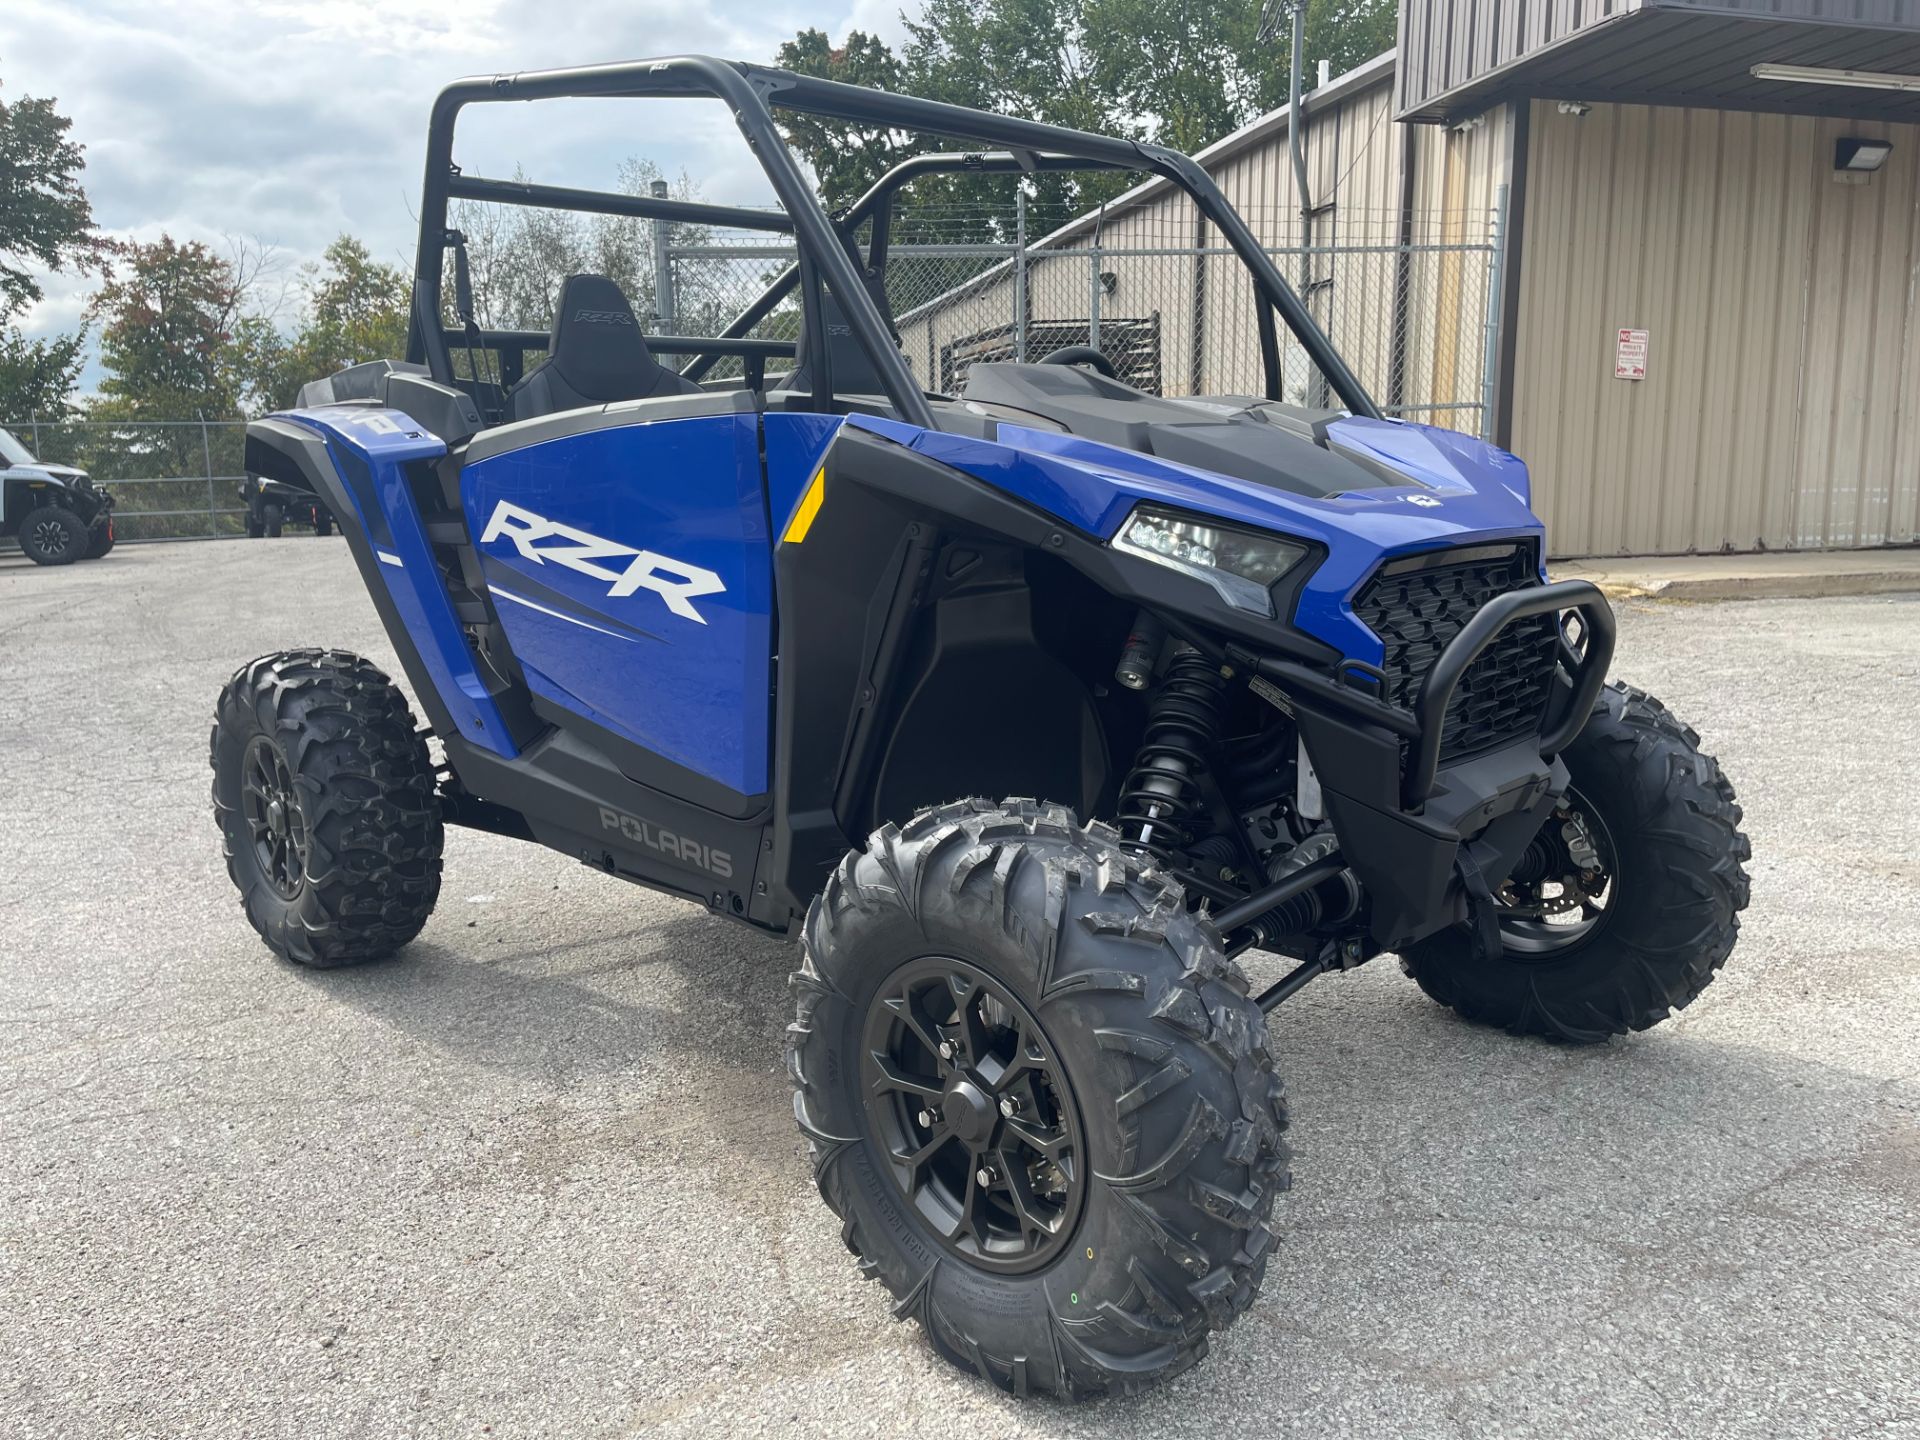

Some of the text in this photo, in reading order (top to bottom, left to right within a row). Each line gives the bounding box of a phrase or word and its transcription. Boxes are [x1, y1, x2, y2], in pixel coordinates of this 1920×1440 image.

[574, 309, 632, 325] RZR
[1620, 333, 1630, 341] NO
[479, 499, 728, 626] RZR
[598, 805, 734, 878] POLARIS
